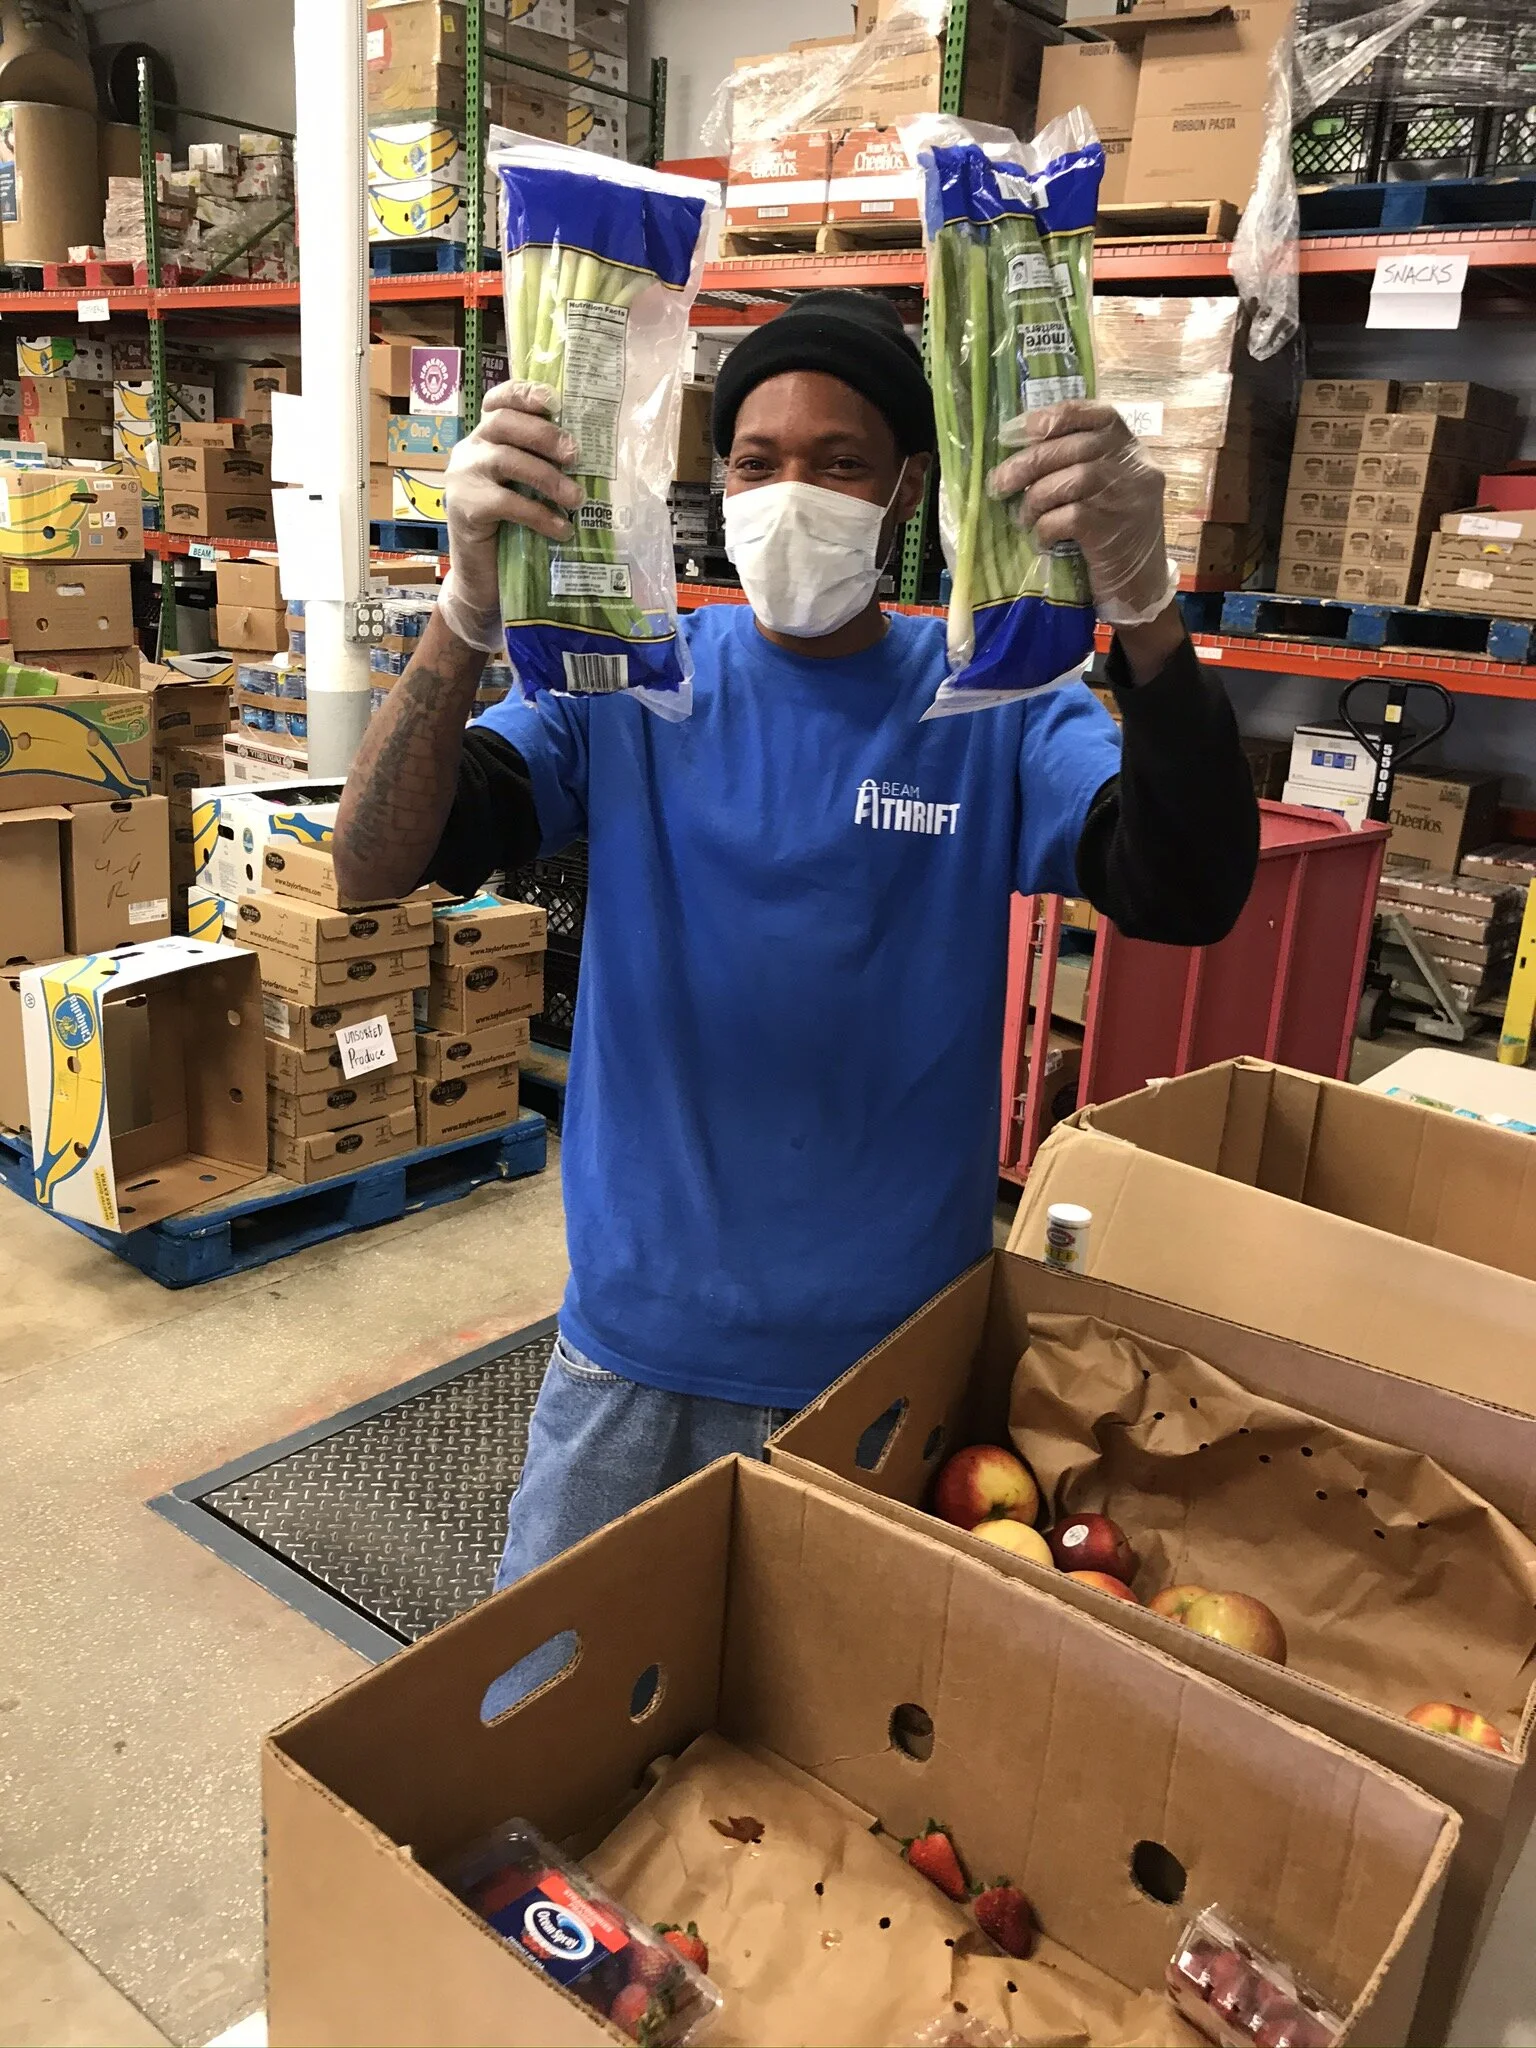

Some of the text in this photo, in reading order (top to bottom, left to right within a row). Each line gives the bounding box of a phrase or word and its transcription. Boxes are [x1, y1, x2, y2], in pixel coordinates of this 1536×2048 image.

[1079, 43, 1111, 57] RIBBON
[1172, 117, 1237, 132] RIBBON PASTA
[1383, 263, 1454, 285] SNACKS
[569, 302, 603, 312] Nutrition
[604, 306, 625, 317] Facts
[1024, 322, 1065, 334] matters
[1026, 332, 1066, 348] more
[481, 356, 504, 371] PREAD
[410, 422, 431, 438] One
[581, 505, 613, 520] more
[193, 547, 211, 558] BEAM
[881, 781, 920, 799] BEAM
[880, 797, 961, 835] THRIFT
[1388, 808, 1442, 835] Cheerios
[275, 877, 322, 897] www.taylorfarms.com
[353, 921, 376, 932] Taylor
[470, 941, 531, 956] www.taylorfarms.com
[352, 963, 373, 974] Taylor
[470, 968, 495, 983] Taylor
[69, 994, 92, 1043] Chiquita
[475, 1002, 533, 1025] www.taylorfarms.com
[347, 1047, 387, 1070] Produce
[461, 1050, 517, 1070] www.taylorfarms.com
[441, 1110, 507, 1134] www.taylorfarms.com
[537, 1910, 580, 1950] Ocean Spray
